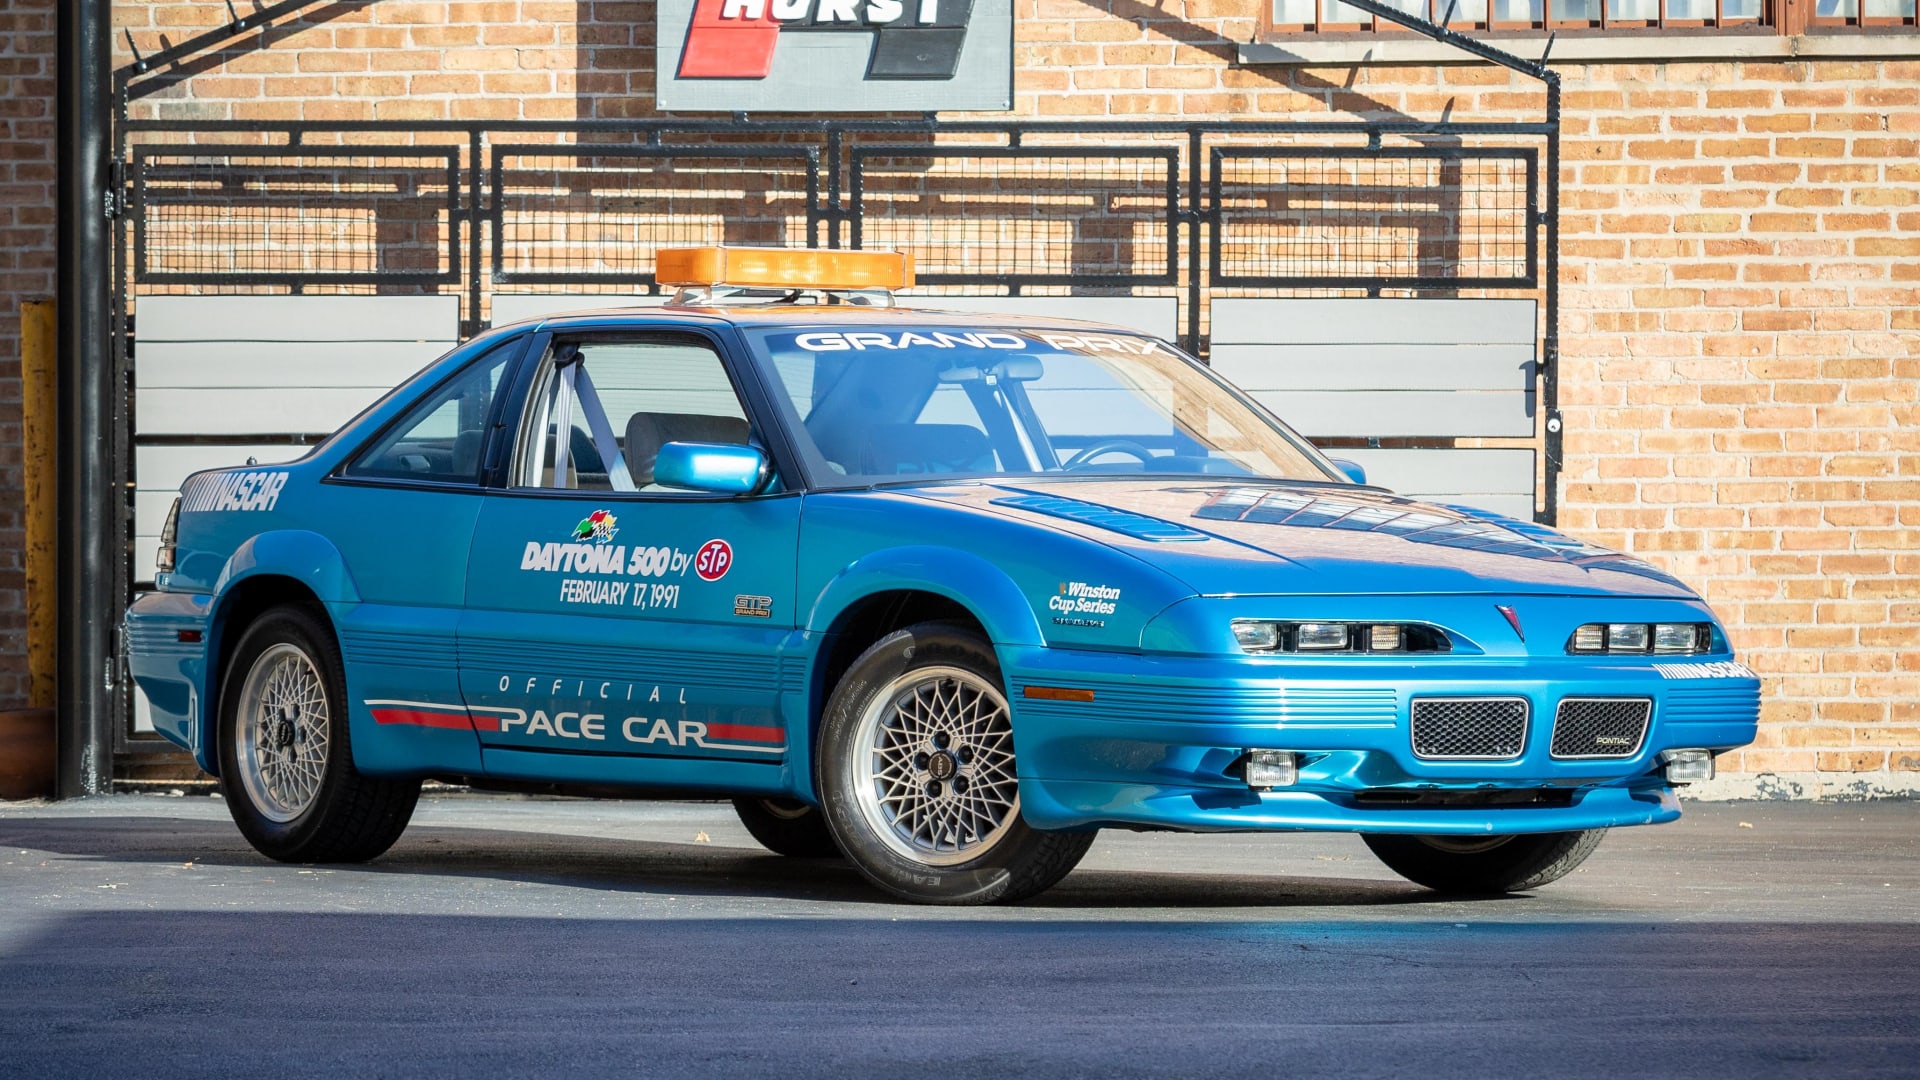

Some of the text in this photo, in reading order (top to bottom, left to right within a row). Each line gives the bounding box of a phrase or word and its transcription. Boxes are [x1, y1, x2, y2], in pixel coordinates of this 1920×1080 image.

[794, 331, 1179, 358] GRAND PRIX
[213, 471, 290, 511] NASCAR
[520, 541, 728, 577] DAYTONA 500 by STP
[559, 578, 630, 606] FEBRUARY
[649, 584, 680, 608] 1991
[735, 595, 772, 609] GTP
[1049, 595, 1116, 615] Cup Series
[1068, 581, 1121, 600] Winston
[499, 675, 686, 704] OFFICIAL
[501, 706, 708, 747] PACE CAR
